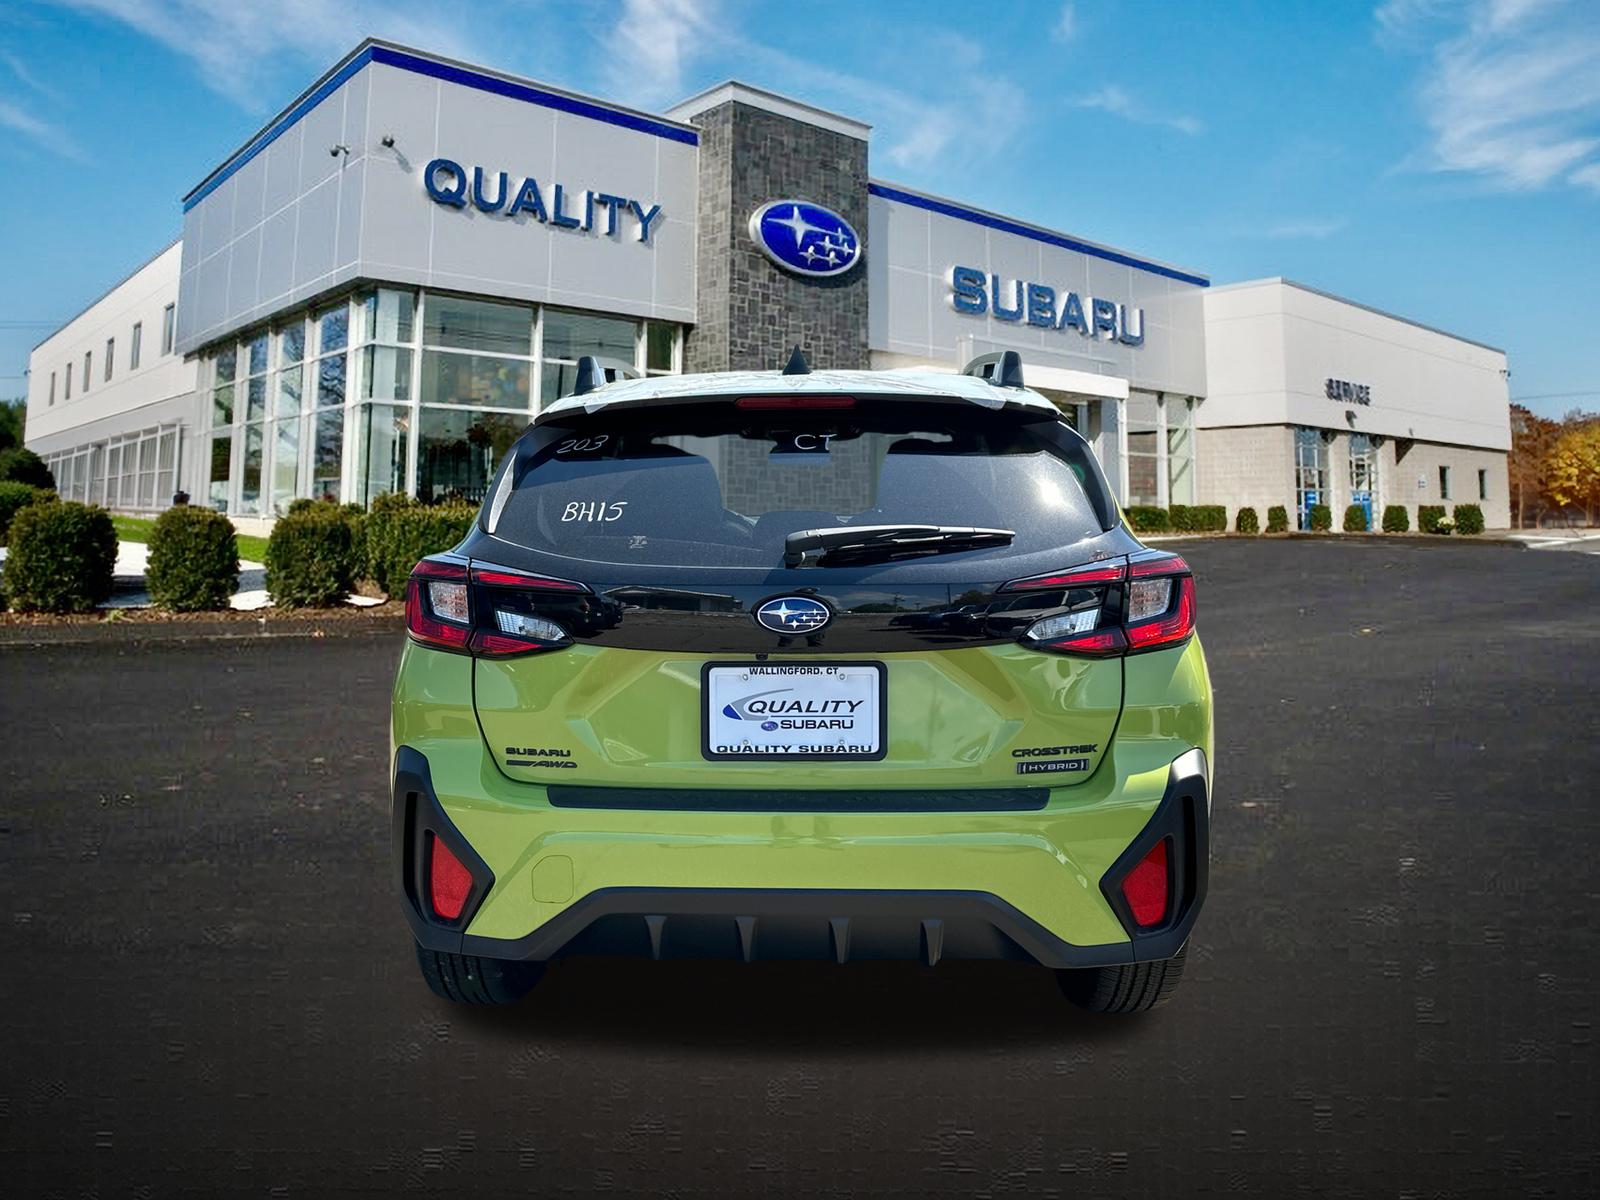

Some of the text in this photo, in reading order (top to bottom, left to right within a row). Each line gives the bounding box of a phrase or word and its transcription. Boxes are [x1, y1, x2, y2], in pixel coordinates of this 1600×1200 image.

[424, 158, 662, 243] QUALITY
[951, 265, 1145, 347] SUBARU
[556, 435, 609, 454] 203
[794, 433, 837, 451] CT
[826, 667, 839, 675] CT
[748, 700, 864, 714] QUALITY
[780, 719, 854, 730] SUBARU
[506, 747, 571, 757] SUBARU
[716, 745, 872, 753] QUALITY SUBARU
[1012, 744, 1098, 757] CROSSTREK
[532, 760, 577, 768] AWD
